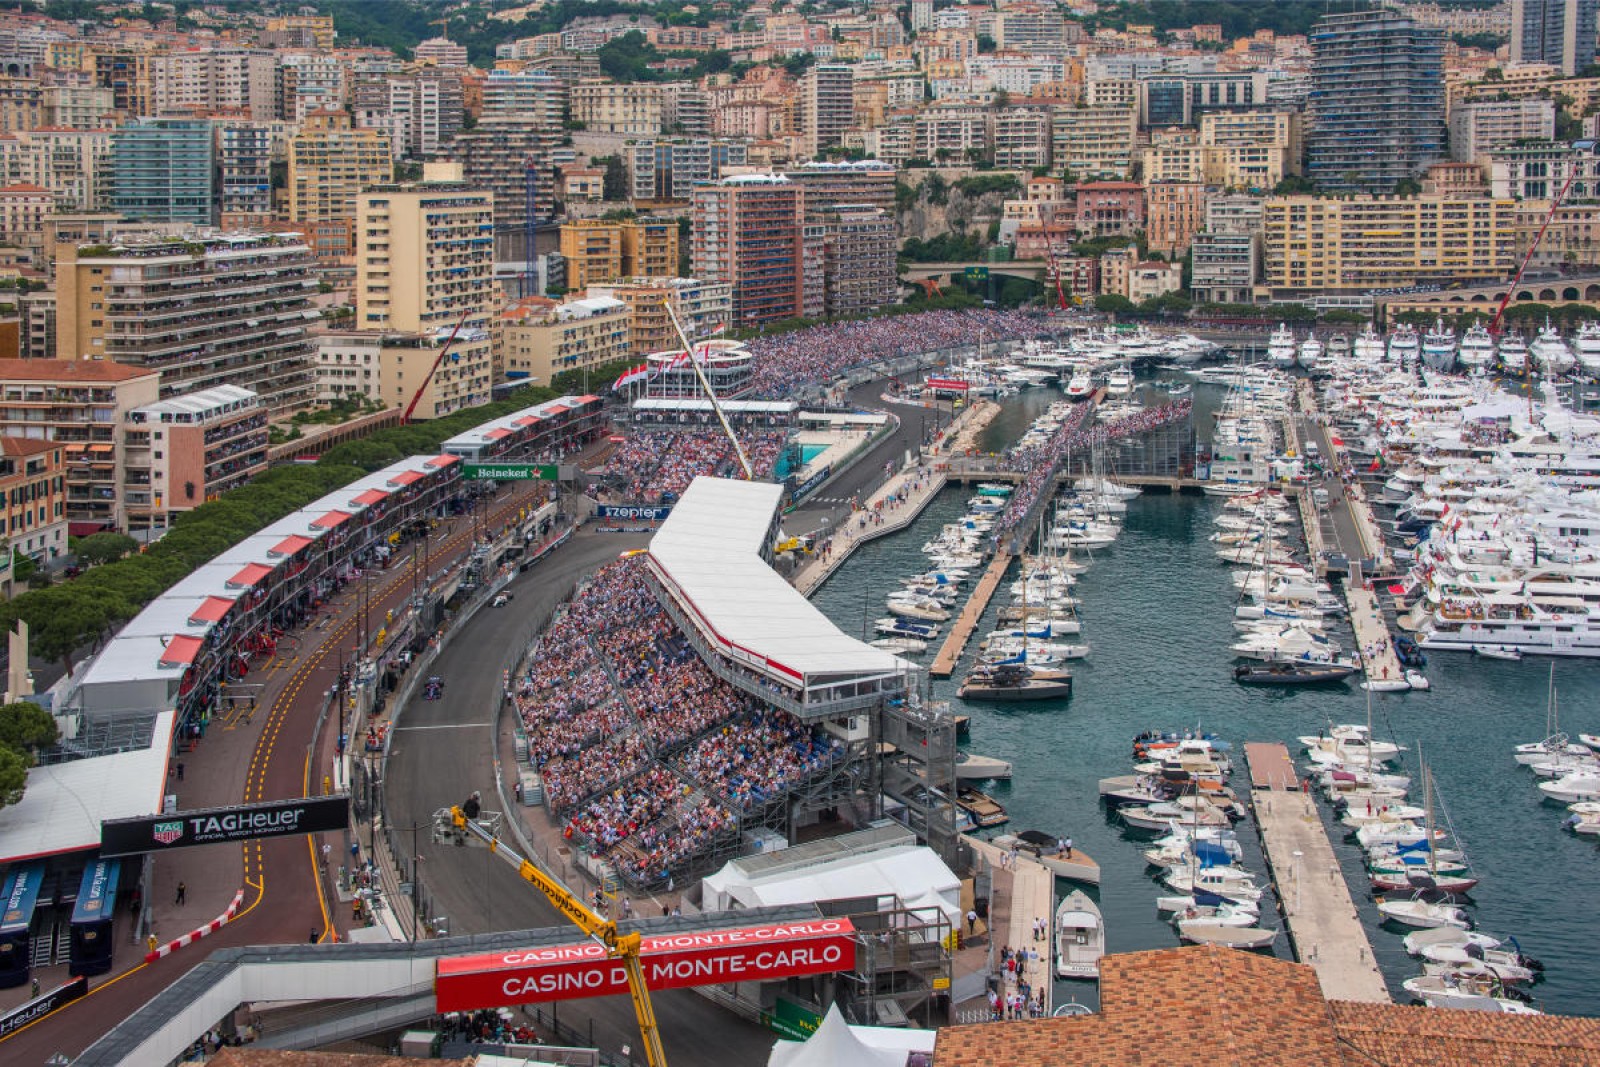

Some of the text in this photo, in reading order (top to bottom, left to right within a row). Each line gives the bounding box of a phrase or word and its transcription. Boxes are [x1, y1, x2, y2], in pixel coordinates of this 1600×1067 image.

[478, 468, 528, 478] Heineken
[503, 947, 604, 964] CASINO
[652, 922, 841, 949] MONTE-CARLO
[503, 970, 604, 995] CASINO
[652, 945, 842, 981] MONTE-CARLO
